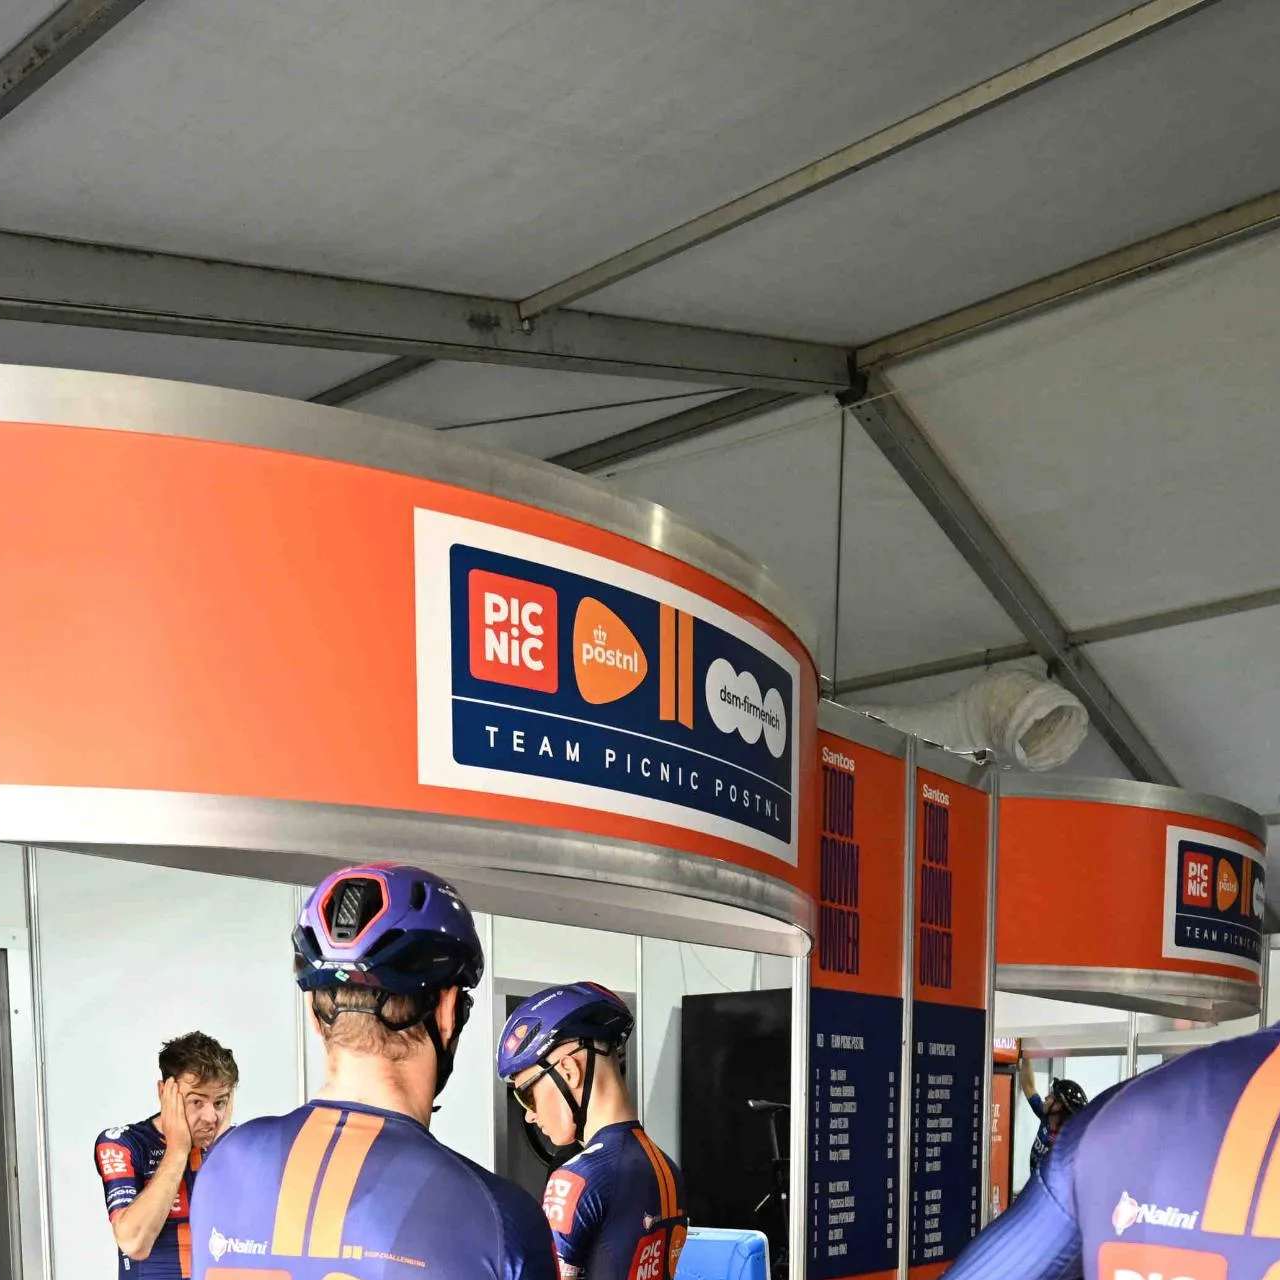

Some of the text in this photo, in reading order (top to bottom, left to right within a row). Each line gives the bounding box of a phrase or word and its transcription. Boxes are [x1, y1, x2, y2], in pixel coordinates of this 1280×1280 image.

[484, 592, 543, 635] PIC
[582, 641, 638, 673] postnl
[720, 686, 780, 731] dsm-firmenich
[485, 726, 780, 821] TEAM PICNIC POSTNL
[822, 747, 855, 772] Santos
[822, 765, 854, 839] TOUR
[923, 784, 950, 805] Santos
[923, 801, 949, 866] TOUR
[821, 835, 860, 908] DOWN
[1188, 862, 1209, 880] PIC
[820, 903, 860, 976] UNDER
[1186, 927, 1218, 940] TEAM
[920, 926, 952, 989] UNDER
[100, 1149, 111, 1175] PIC
[1137, 1204, 1199, 1230] Nalini
[227, 1237, 267, 1256] Nalini
[640, 1240, 661, 1263] PIC
